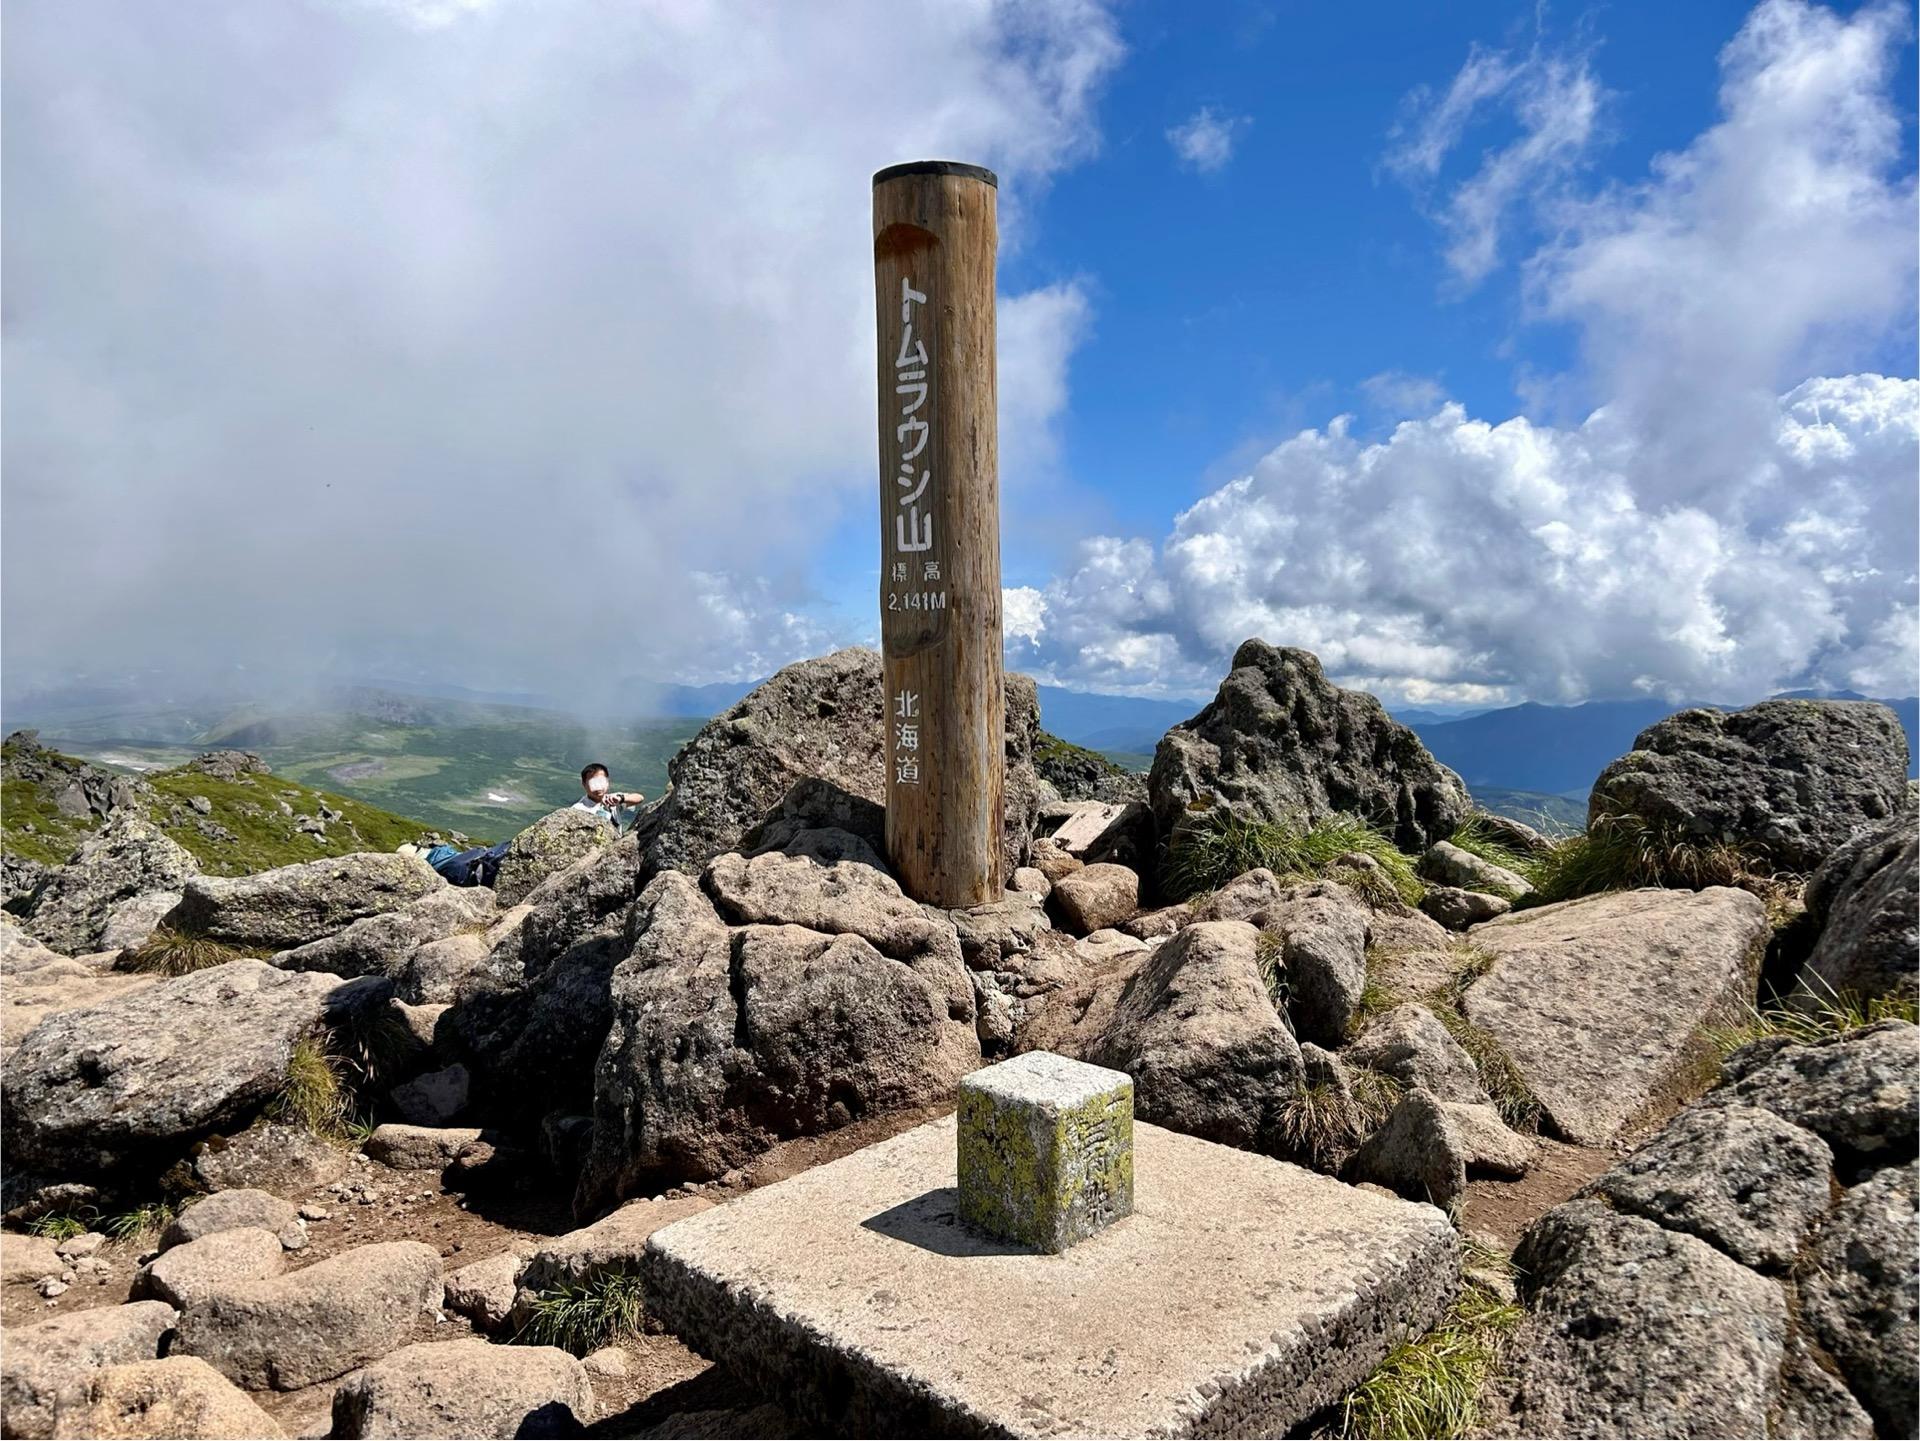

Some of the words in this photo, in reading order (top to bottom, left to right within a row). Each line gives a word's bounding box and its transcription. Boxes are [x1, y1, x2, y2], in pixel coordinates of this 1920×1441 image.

[895, 277, 932, 552] トムラウシ山
[892, 561, 941, 582] 標高
[894, 689, 920, 785] 北海道
